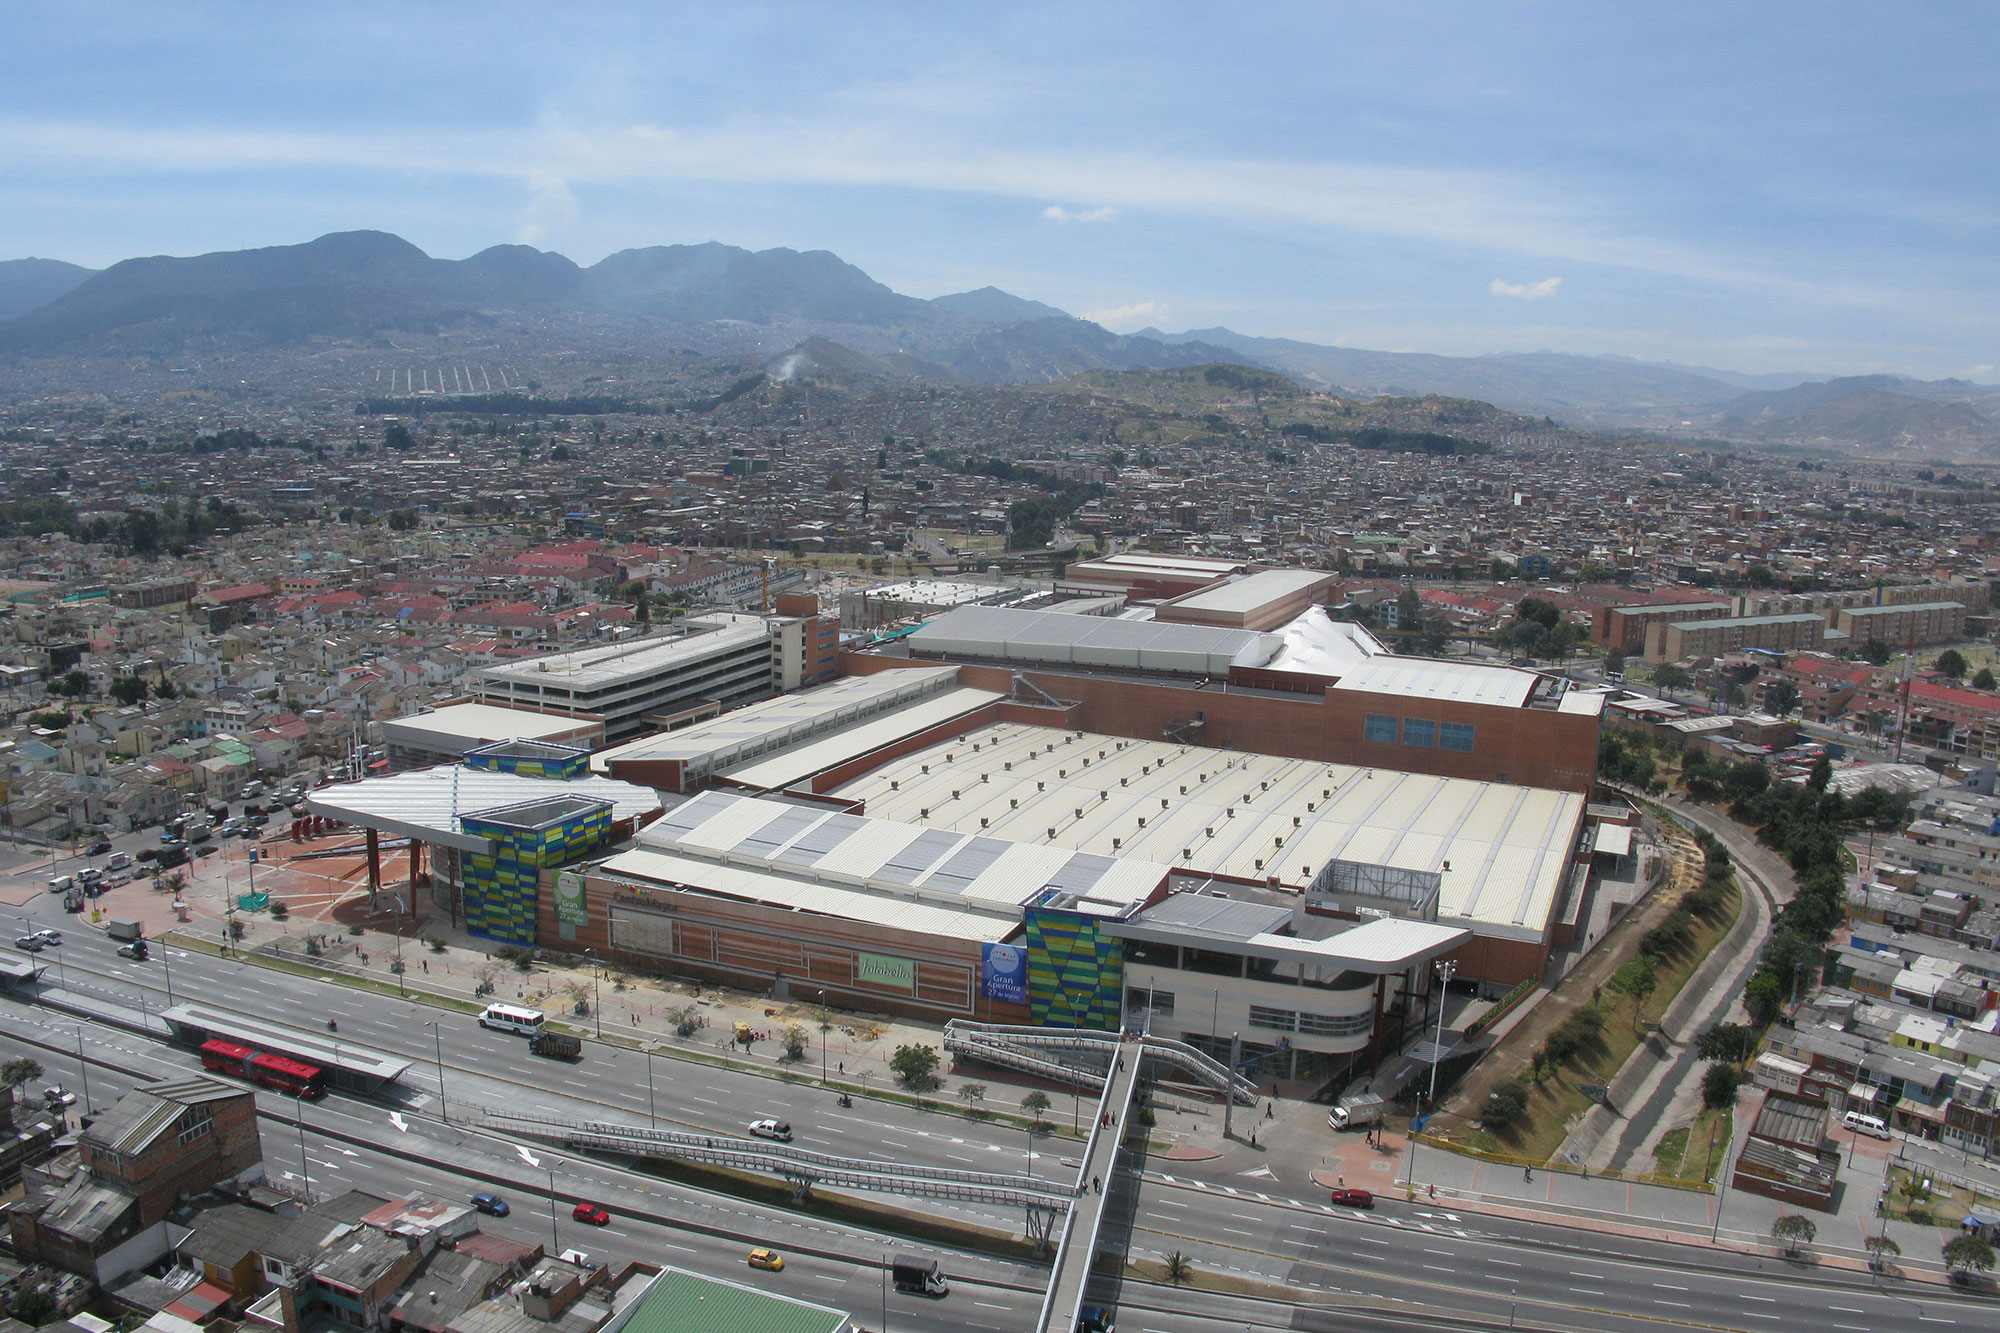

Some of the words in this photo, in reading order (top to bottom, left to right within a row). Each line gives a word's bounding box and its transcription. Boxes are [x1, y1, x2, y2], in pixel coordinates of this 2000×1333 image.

[561, 899, 578, 909] Gran
[861, 958, 910, 980] falabella
[993, 974, 1014, 985] Gran
[987, 980, 1021, 992] Apertura
[988, 989, 997, 997] 27
